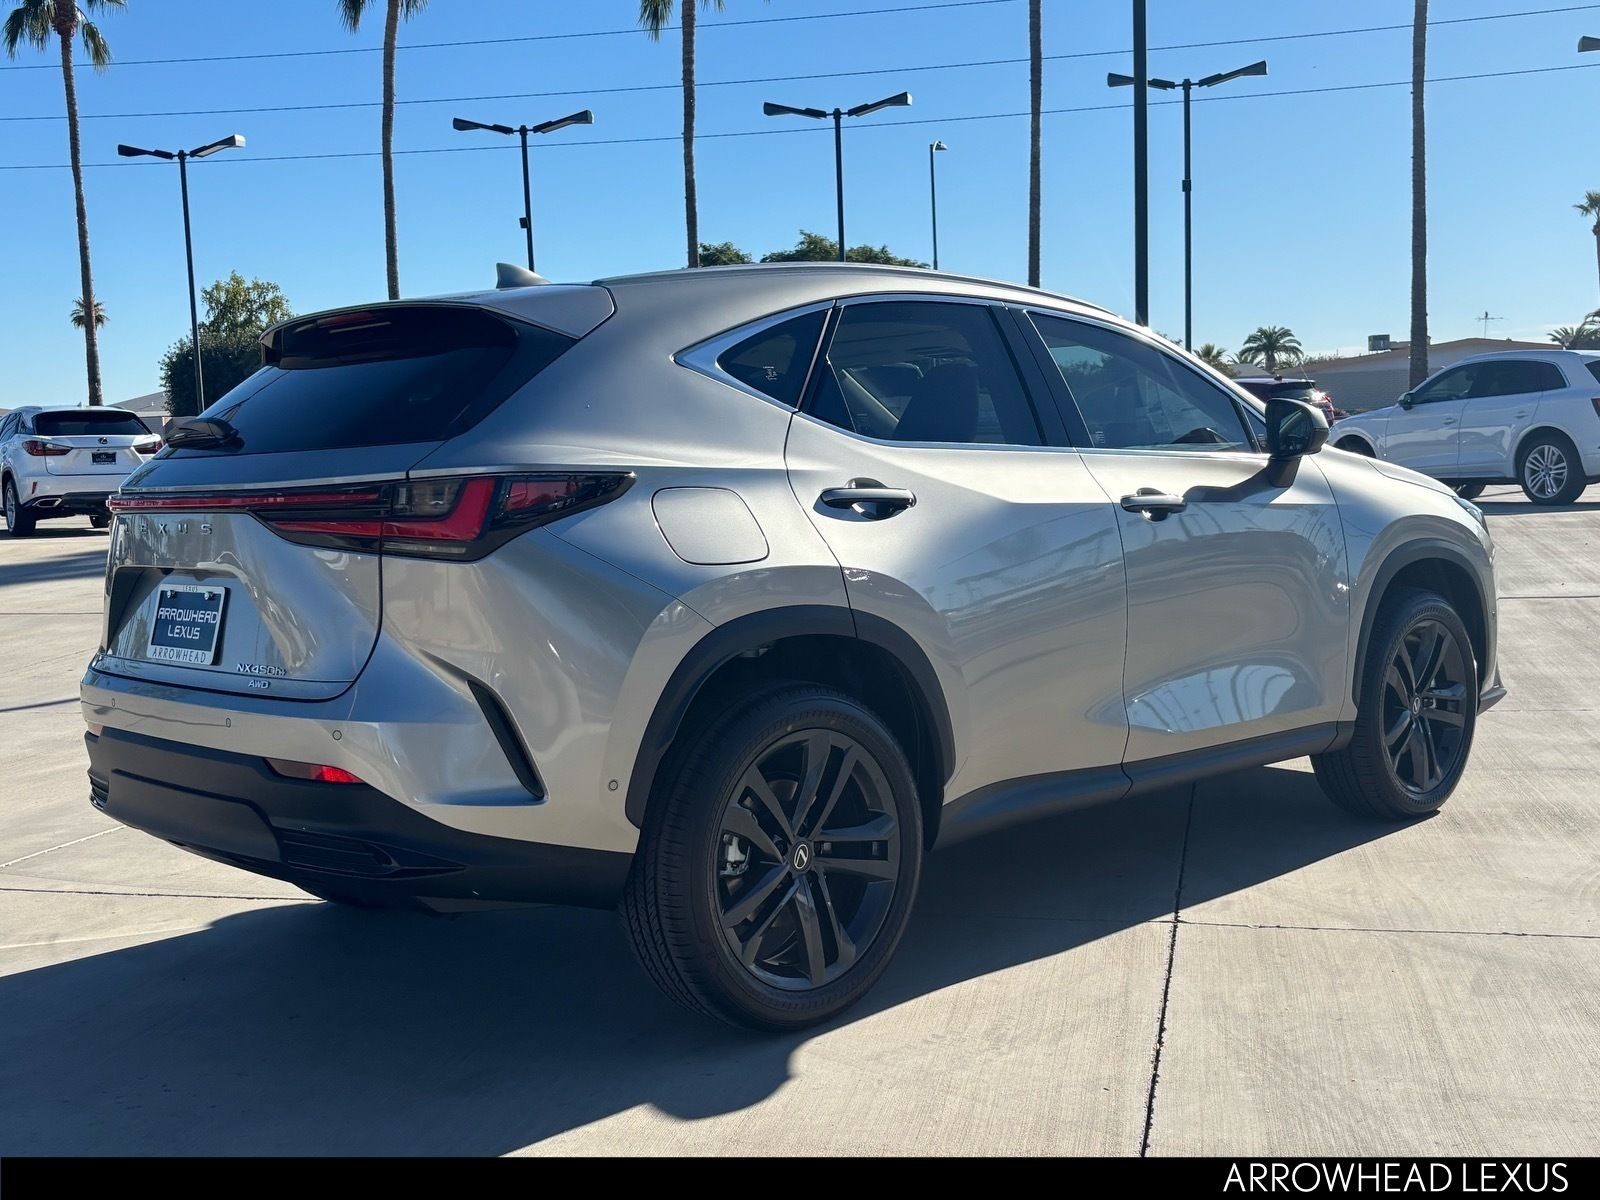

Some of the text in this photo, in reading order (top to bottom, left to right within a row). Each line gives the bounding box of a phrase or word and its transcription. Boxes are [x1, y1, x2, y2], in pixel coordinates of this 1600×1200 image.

[158, 608, 218, 623] ARROWHEAD
[167, 625, 200, 639] LEXUS
[152, 647, 206, 662] ARROWHEAD
[247, 680, 271, 689] AWD
